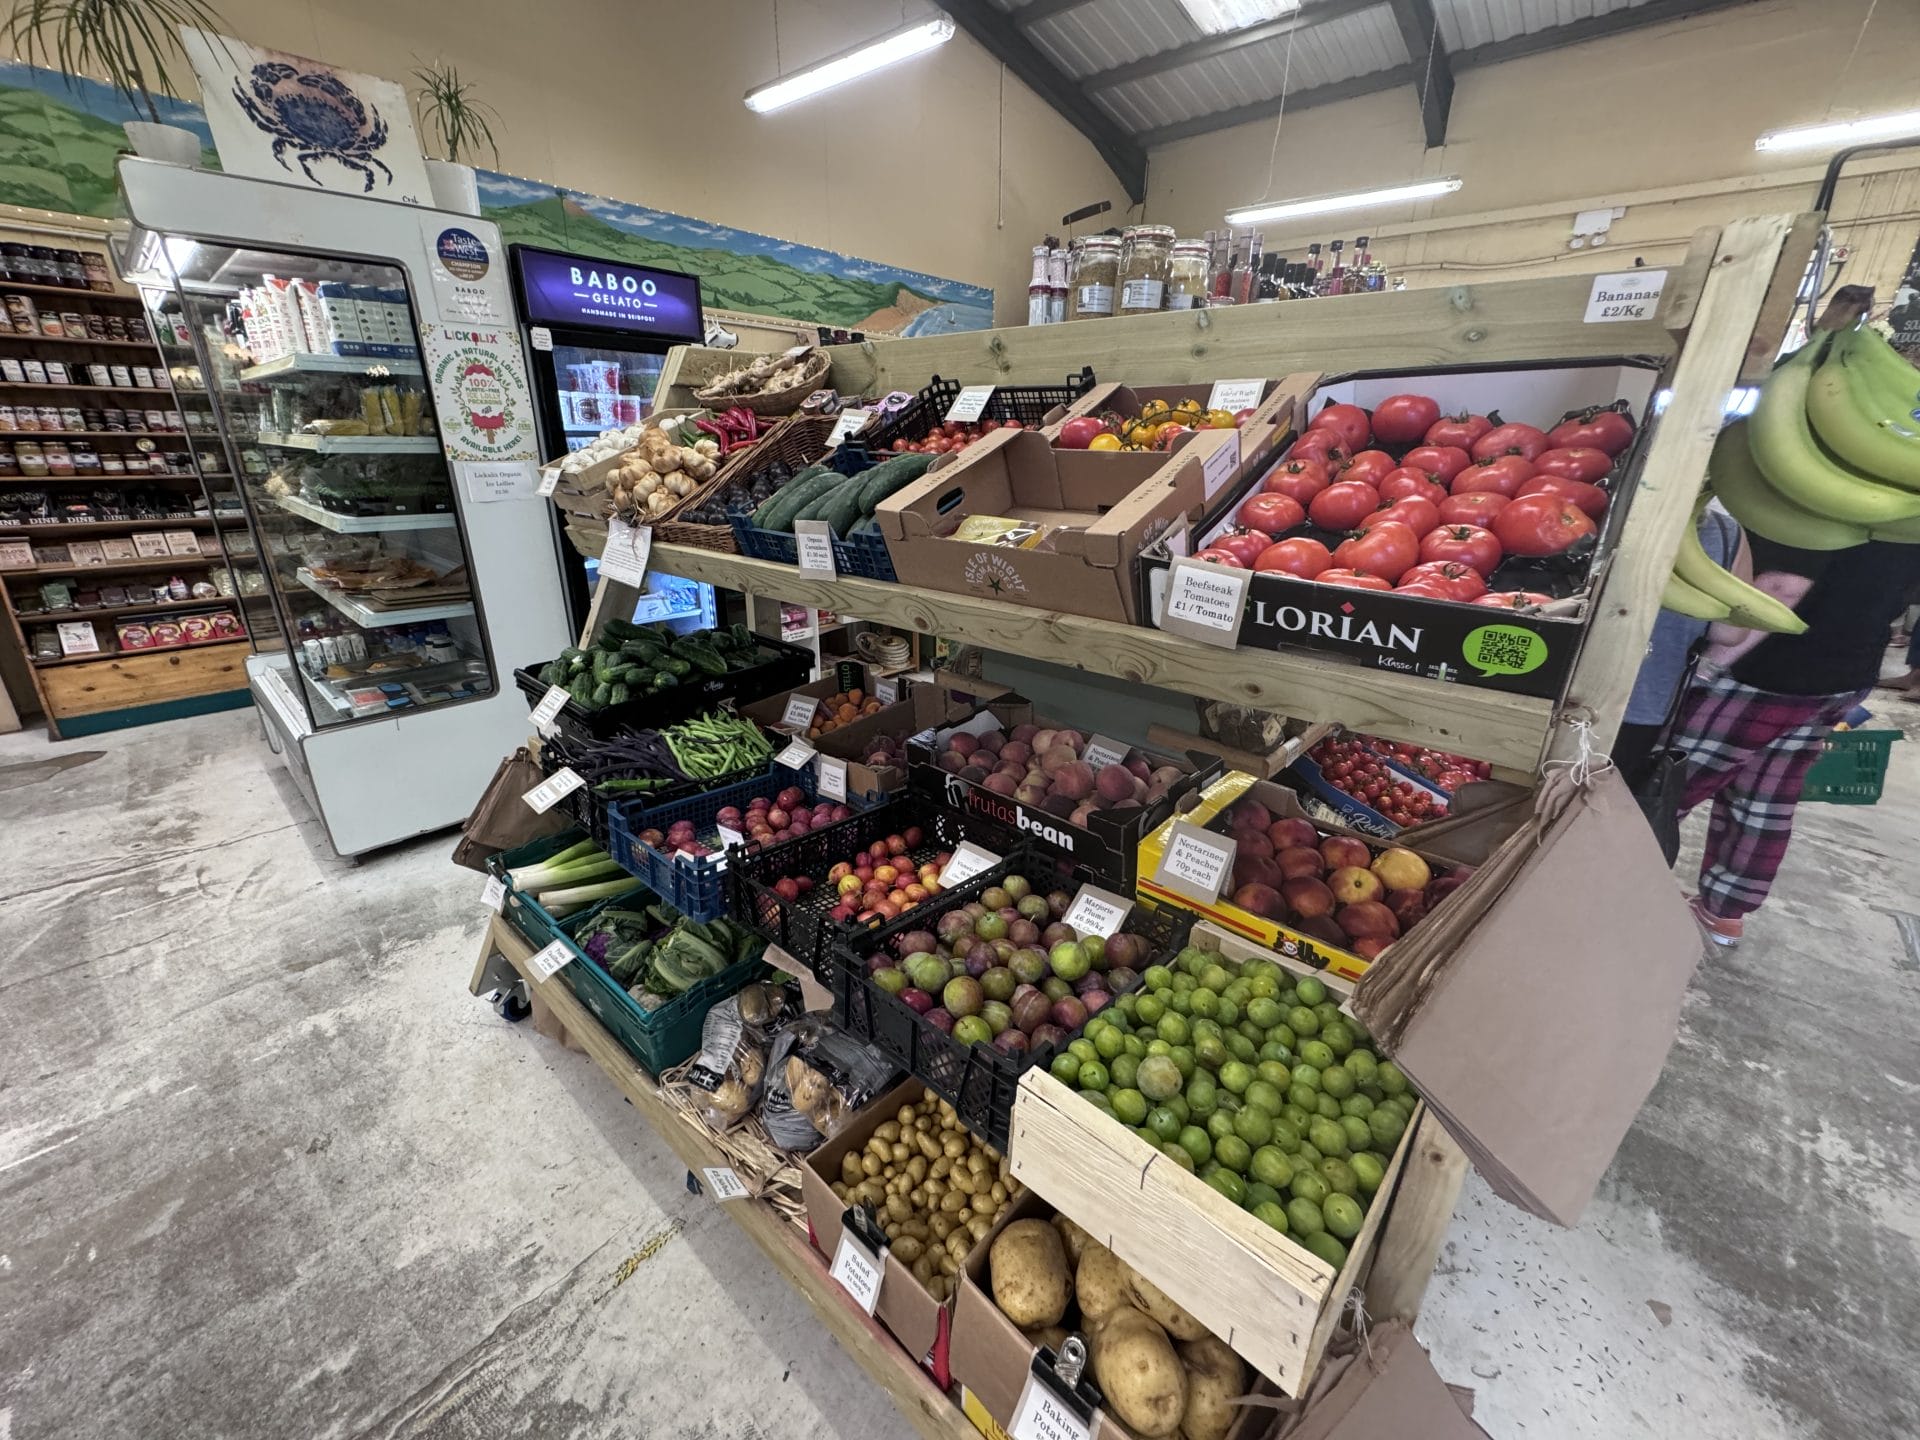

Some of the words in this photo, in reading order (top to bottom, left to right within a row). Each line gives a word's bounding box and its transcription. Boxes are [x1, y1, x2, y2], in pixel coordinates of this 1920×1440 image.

[451, 233, 477, 245] Taste
[454, 243, 479, 256] West
[451, 261, 481, 269] CHAMPION
[455, 286, 485, 295] BABOO
[570, 266, 657, 296] BABOO
[592, 292, 641, 309] GELATO
[1595, 290, 1660, 303] Bananas
[581, 307, 617, 318] HANDMADE
[1601, 304, 1645, 318] £2/Kg
[434, 353, 455, 385] ORGANIC
[454, 349, 461, 358] &
[461, 347, 500, 363] NATURAL
[500, 360, 525, 389] LOLLIES
[469, 378, 495, 388] 100%
[460, 435, 503, 453] AVAILABLE
[503, 434, 523, 451] HERE!
[29, 517, 60, 525] DINE
[67, 516, 96, 524] DINE
[166, 511, 193, 519] DINE
[965, 558, 979, 583] ISLE
[975, 552, 988, 564] OF
[991, 553, 1027, 592] WIGHT
[975, 565, 1014, 590] TOMATOES
[1185, 575, 1234, 596] Beefsteak
[1184, 588, 1230, 608] Tomatoes
[1174, 600, 1186, 611] £1
[1195, 604, 1234, 623] Tomato
[1253, 600, 1424, 653] LORIAN
[1378, 654, 1413, 670] Klasse
[1178, 837, 1225, 863] Nectarines
[1175, 848, 1183, 857] &
[1185, 852, 1219, 873] Peaches
[1175, 860, 1191, 872] 70p
[1191, 869, 1212, 881] each
[1083, 906, 1105, 921] Plums
[1084, 897, 1114, 915] Marjorie
[851, 1254, 870, 1278] Salad
[845, 1260, 871, 1293] Potatoes
[1033, 1411, 1064, 1440] Potat
[1042, 1400, 1080, 1440] Baking
